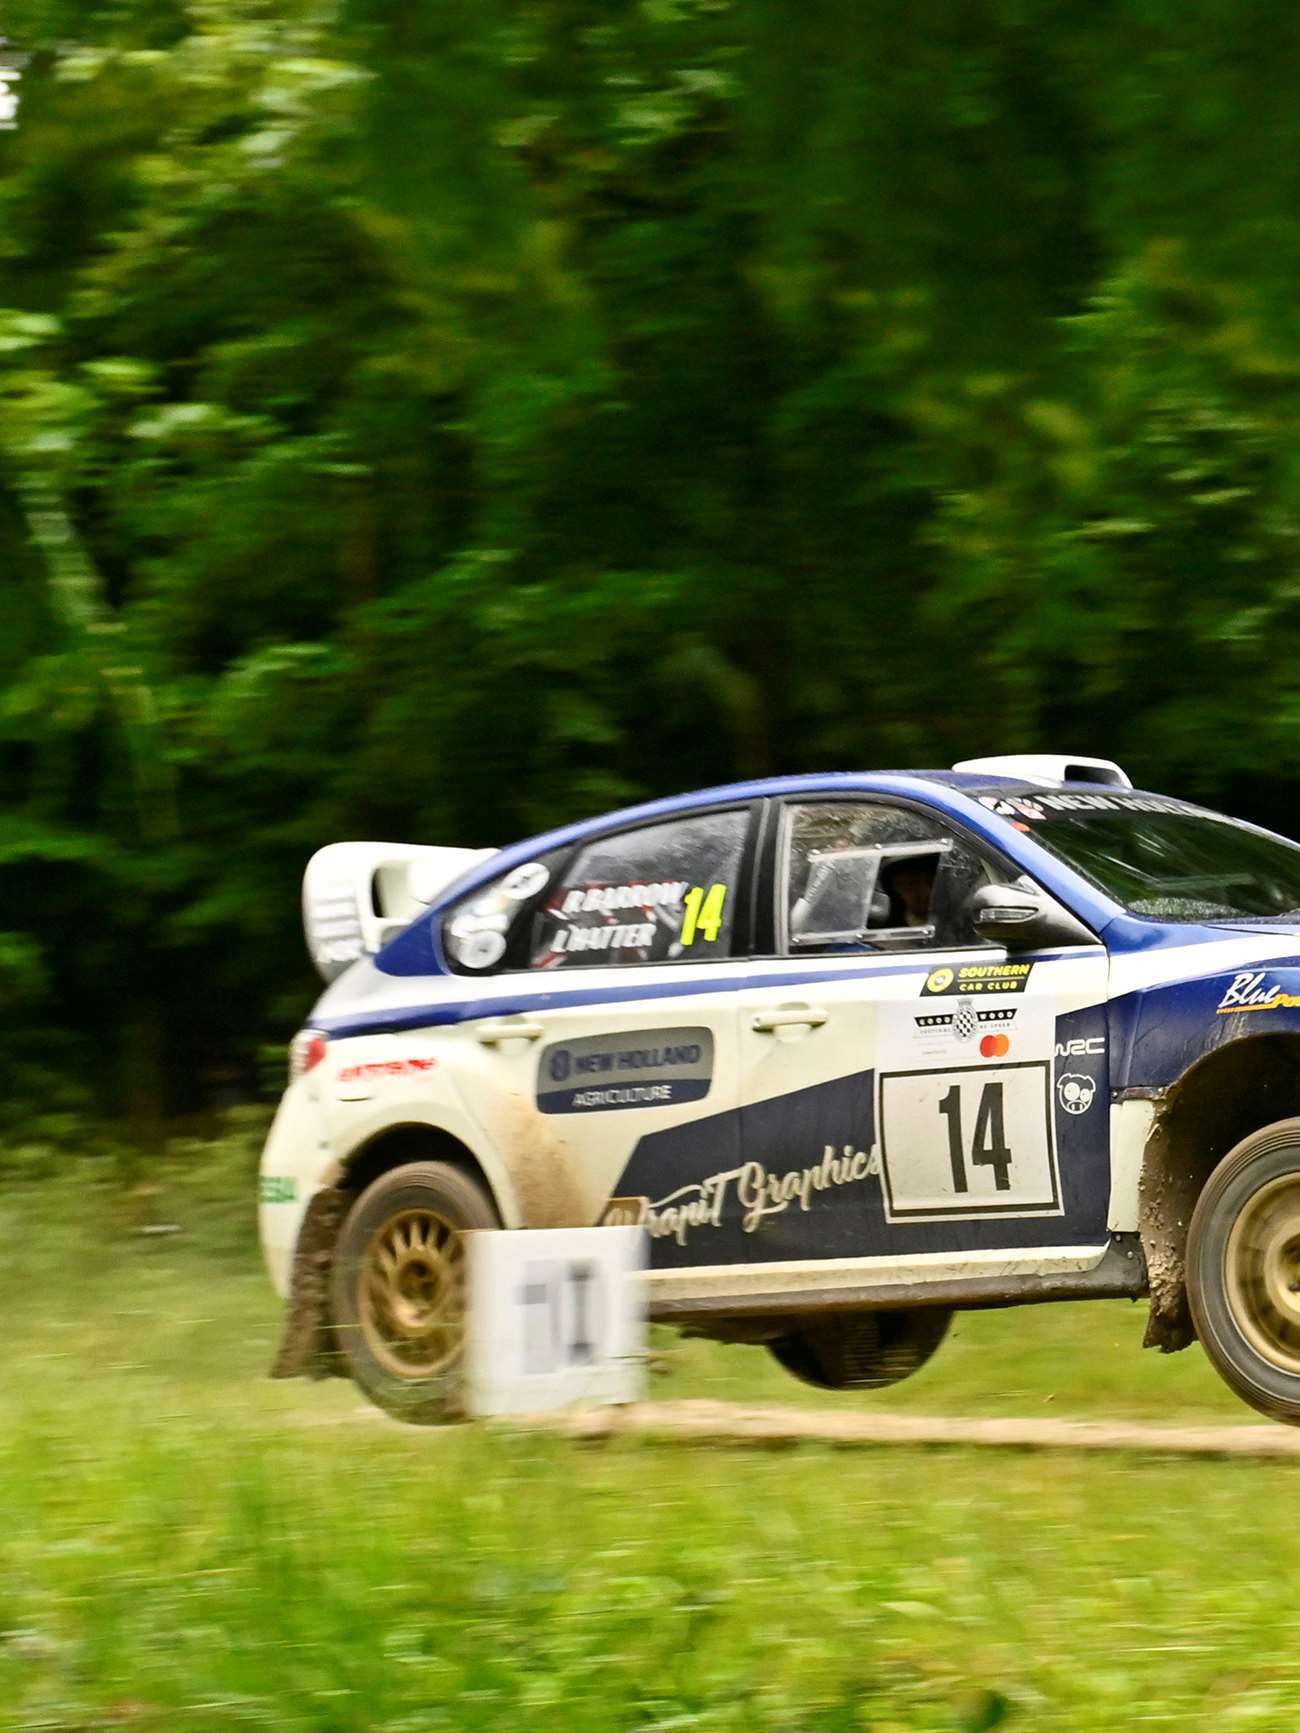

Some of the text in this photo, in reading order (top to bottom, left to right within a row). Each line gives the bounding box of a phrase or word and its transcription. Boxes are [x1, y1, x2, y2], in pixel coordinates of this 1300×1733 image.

[680, 883, 728, 946] 14
[958, 964, 1030, 978] SOUTHERN
[959, 981, 1018, 992] CAR CLUB
[1217, 972, 1280, 1009] Blue
[575, 1044, 701, 1073] NEW HOLLAND
[1054, 1037, 1105, 1057] WRC
[572, 1084, 673, 1107] AGRICULTURE
[938, 1082, 1012, 1194] 14
[737, 1141, 879, 1233] Graphics
